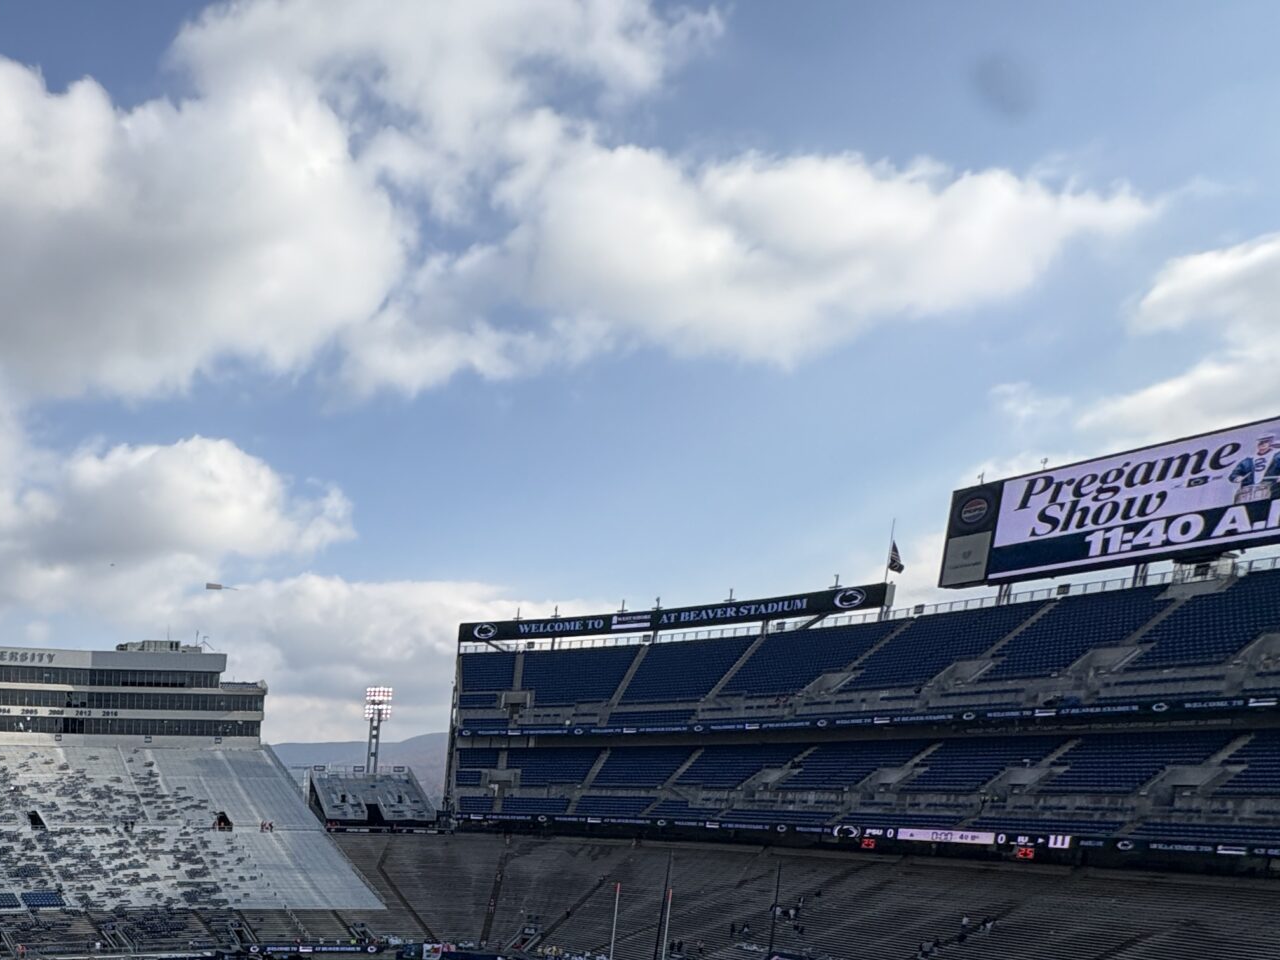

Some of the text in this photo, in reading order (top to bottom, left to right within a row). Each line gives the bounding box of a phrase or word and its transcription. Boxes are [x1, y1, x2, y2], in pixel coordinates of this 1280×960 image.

[1014, 441, 1241, 512] Pregame
[1029, 490, 1168, 537] Show
[1085, 500, 1280, 557] 11:40 A.
[658, 598, 808, 624] AT BEAVER STADIUM
[519, 619, 604, 634] WELCOME TO
[865, 828, 894, 838] PSU 0
[997, 833, 1006, 844] 0
